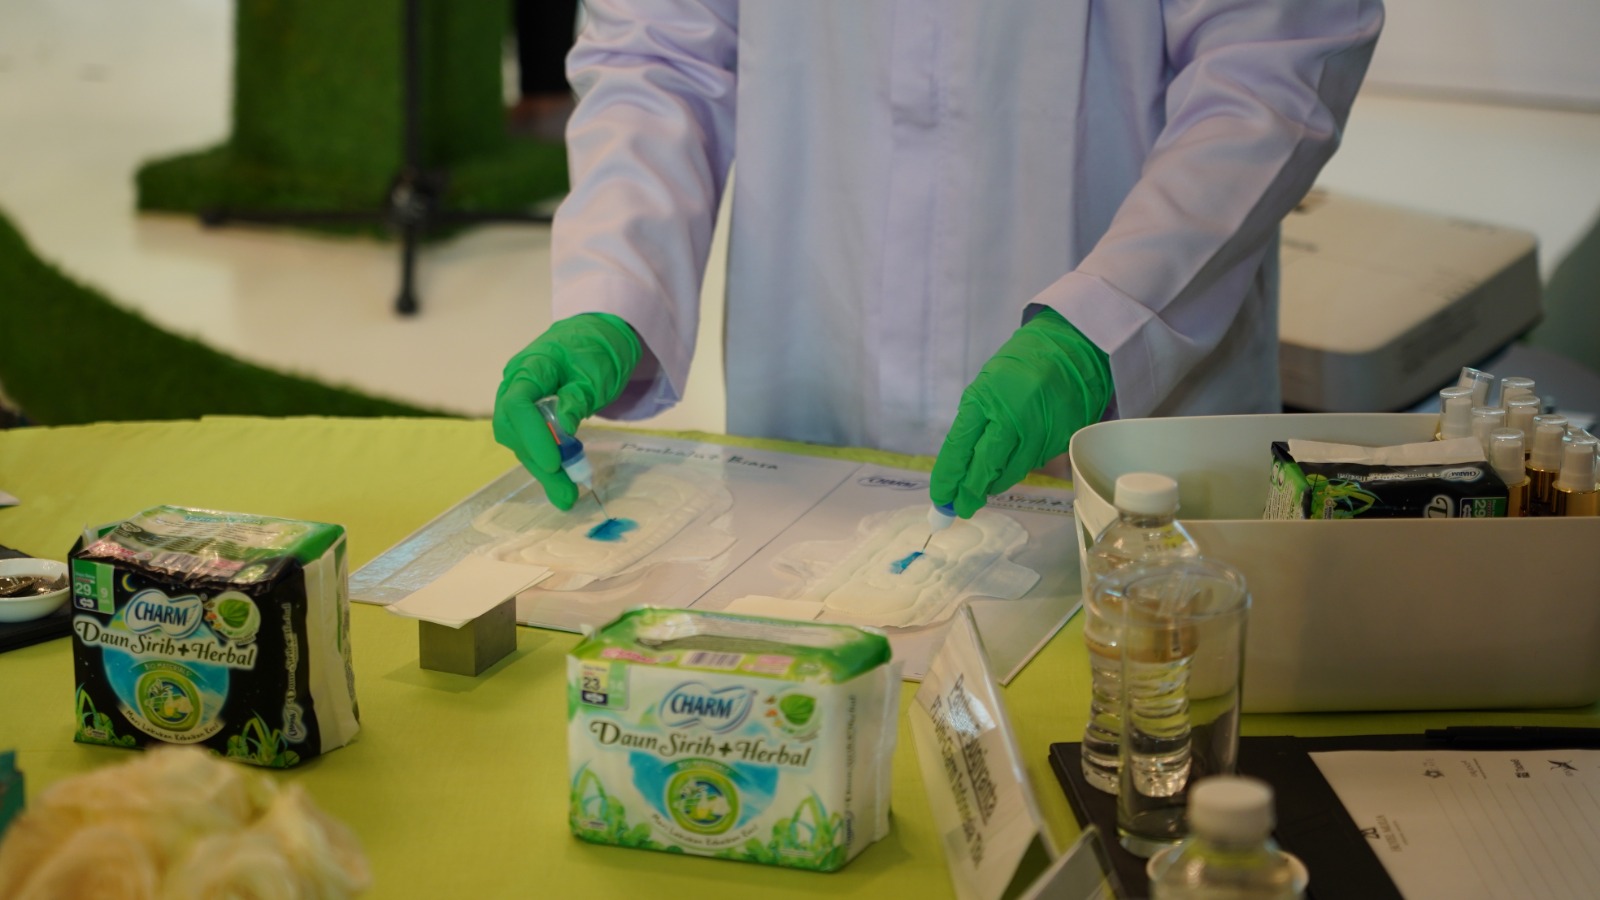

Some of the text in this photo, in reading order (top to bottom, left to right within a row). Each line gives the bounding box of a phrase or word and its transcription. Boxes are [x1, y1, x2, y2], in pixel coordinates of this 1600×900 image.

[75, 582, 91, 596] 29
[134, 598, 190, 627] CHARM
[76, 620, 129, 648] Daun
[131, 634, 175, 656] Sirih
[190, 642, 255, 667] Herbal
[583, 676, 601, 691] 23
[670, 692, 735, 718] CHARM
[589, 720, 658, 750] Daun
[659, 733, 716, 757] Sirih
[734, 741, 812, 768] Herbal
